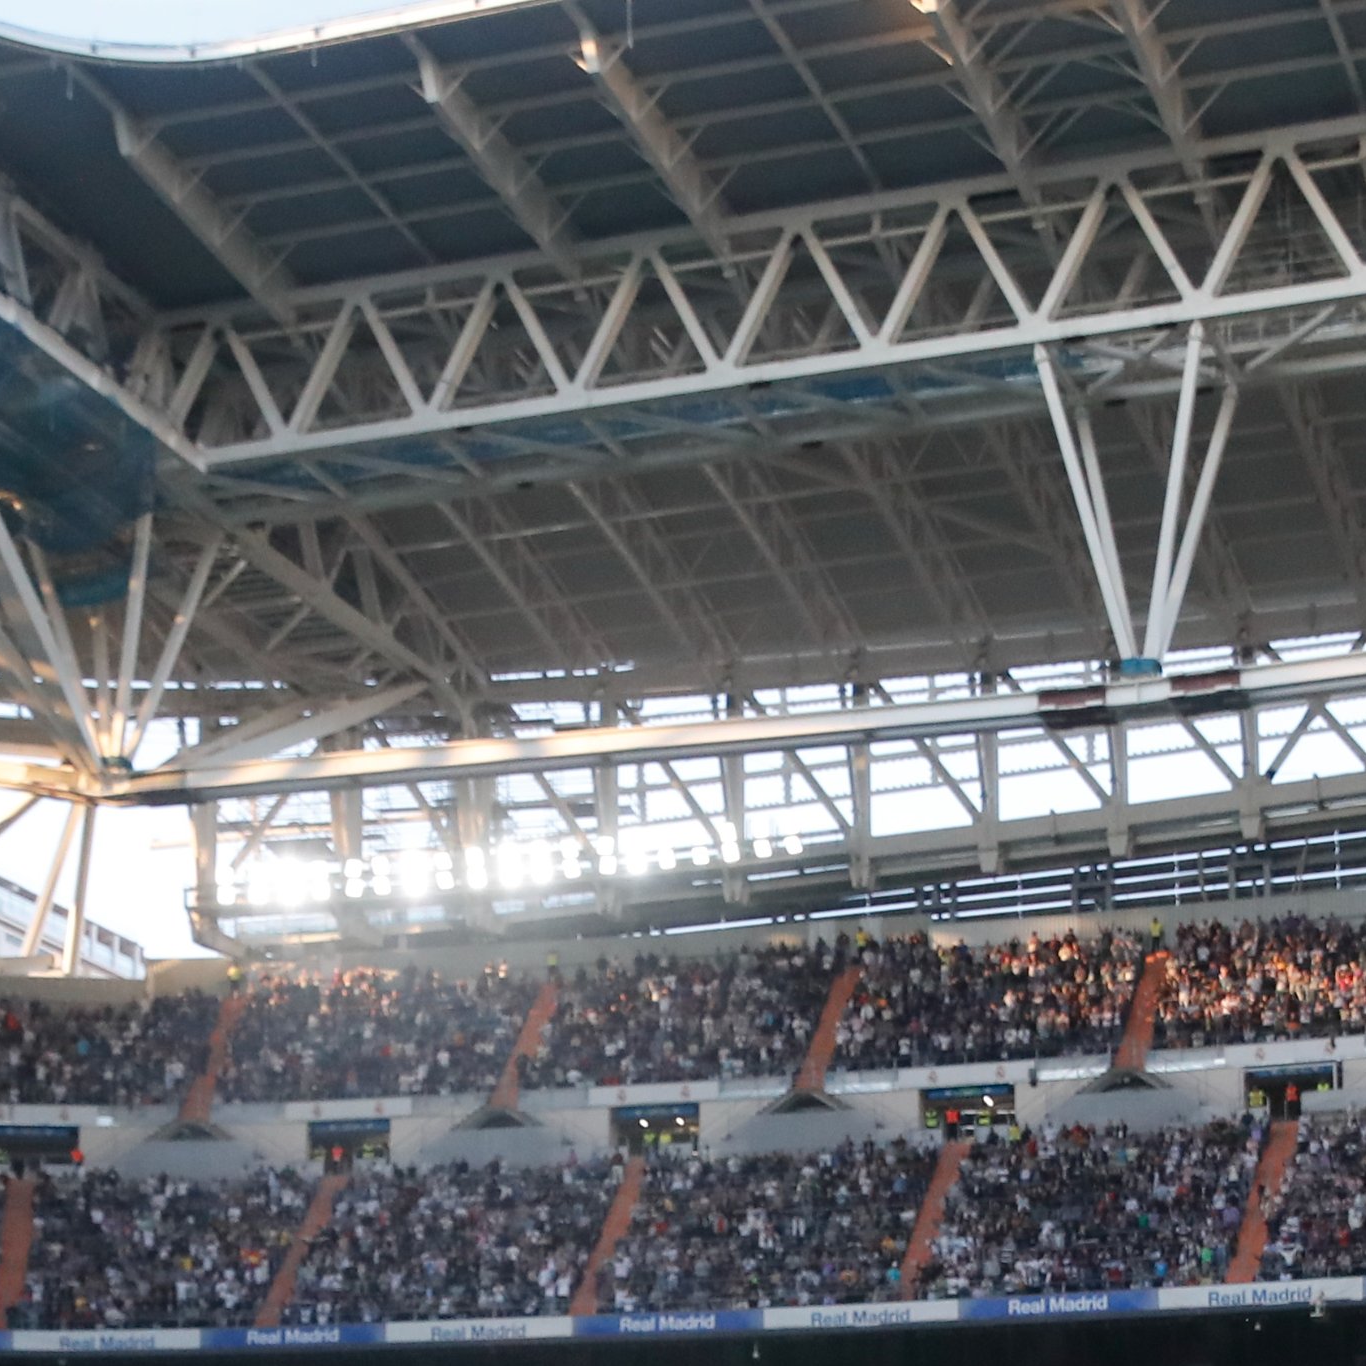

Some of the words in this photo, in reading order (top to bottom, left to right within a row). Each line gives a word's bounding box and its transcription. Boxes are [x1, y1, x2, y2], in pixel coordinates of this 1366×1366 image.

[1008, 1297, 1045, 1316] Real
[1049, 1294, 1109, 1313] Madrid
[1207, 1289, 1246, 1307] Real
[1251, 1285, 1313, 1306] Madrid
[619, 1316, 655, 1333] Real
[659, 1314, 716, 1331] Madrid
[810, 1310, 847, 1327] Real
[851, 1307, 911, 1326] Madrid
[246, 1329, 281, 1346] Real
[284, 1328, 340, 1344] Madrid
